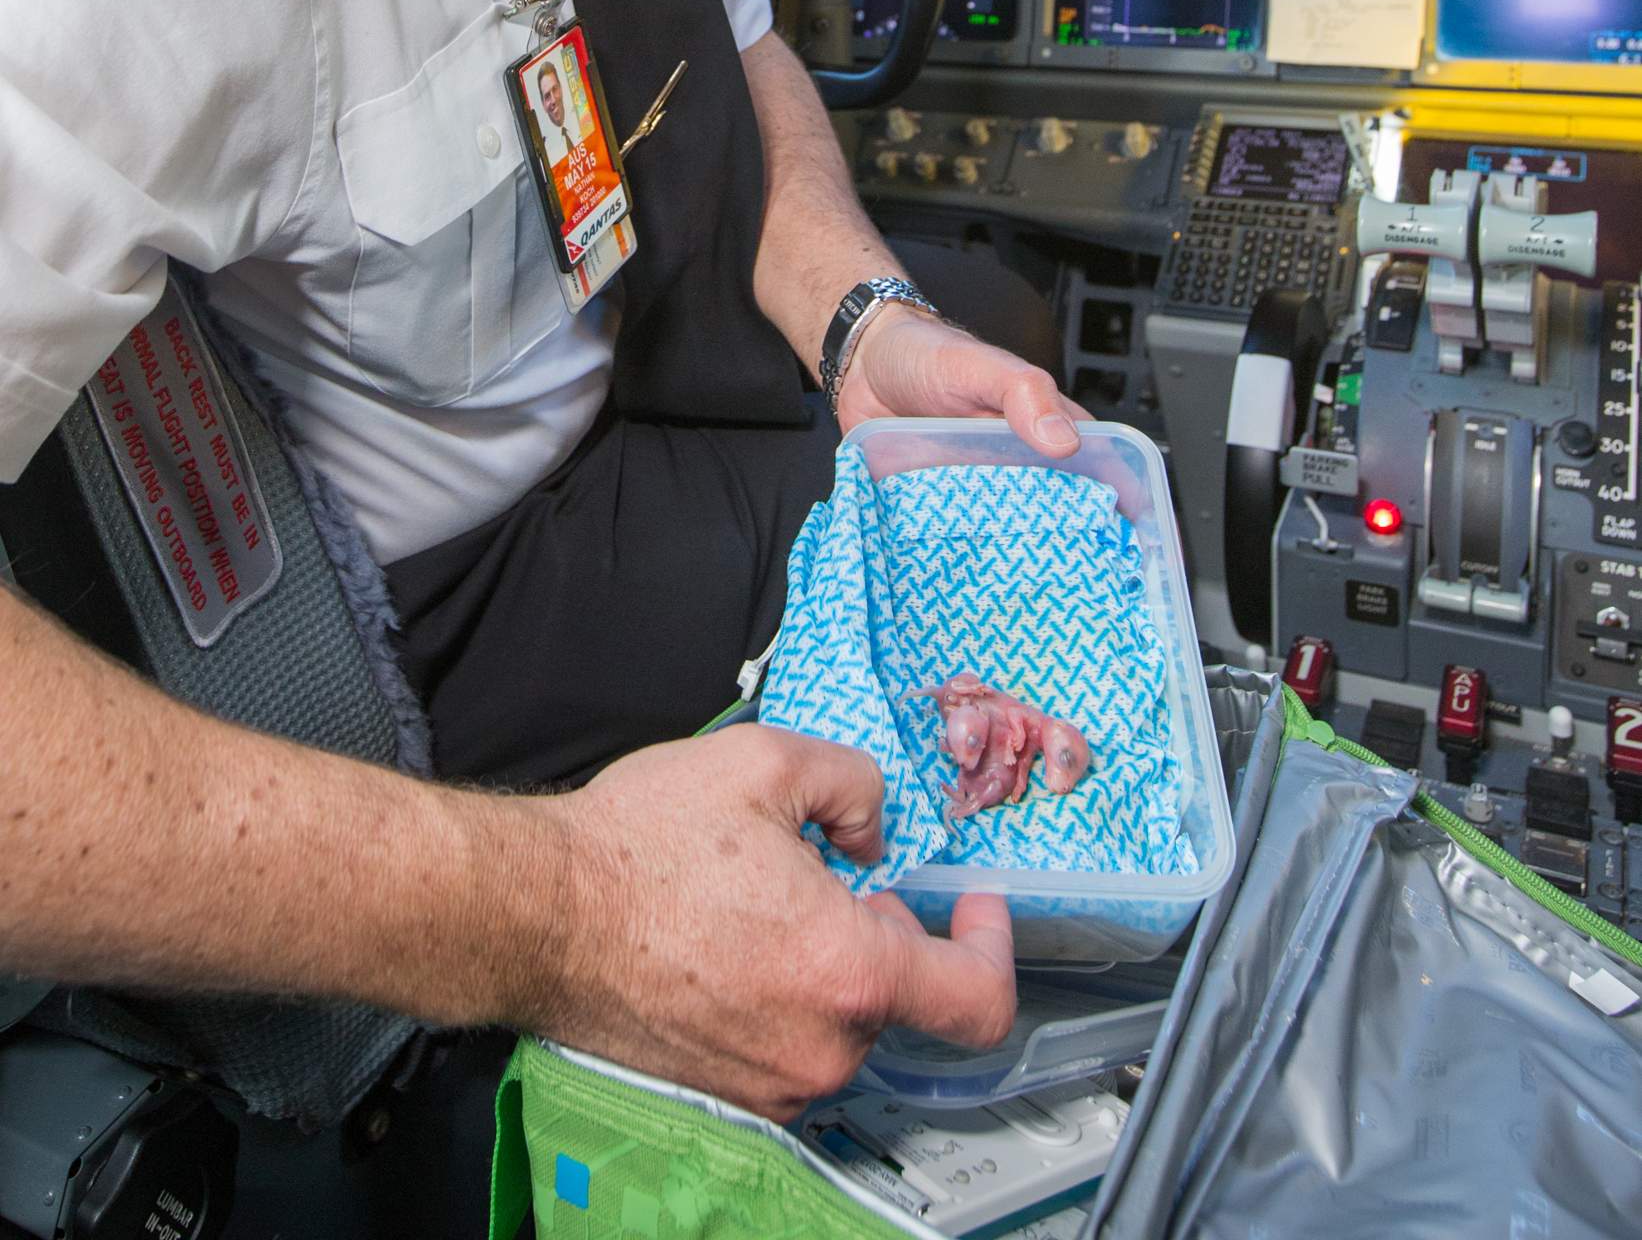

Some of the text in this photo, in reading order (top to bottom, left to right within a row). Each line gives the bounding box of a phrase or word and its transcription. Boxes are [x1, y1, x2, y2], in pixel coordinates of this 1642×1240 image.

[567, 143, 588, 170] AUS
[564, 161, 585, 191] MAY
[581, 197, 622, 247] QANTAS
[1406, 206, 1418, 222] 1
[1529, 215, 1545, 233] 2
[1384, 234, 1438, 246] DISENGAGE
[1507, 245, 1566, 259] DISENGAGE
[1610, 340, 1628, 353] 10
[1610, 368, 1627, 382] 15
[1603, 400, 1625, 417] 25
[164, 316, 261, 551] BACK REST MUST BE IN
[1600, 436, 1624, 455] 30
[130, 323, 241, 606] RMAL FLIGHT POSITION WHEN
[1302, 461, 1338, 475] BRAKE
[98, 356, 208, 612] EAT IS MOVING OUTBOARD
[1302, 471, 1334, 486] PULL
[1597, 484, 1623, 502] 40
[1603, 514, 1636, 529] FLAP
[1601, 524, 1637, 540] DOWN
[1600, 559, 1636, 578] STAB
[1295, 644, 1315, 680] 1
[1452, 673, 1473, 713] APU
[1614, 707, 1642, 748] 2
[156, 1189, 195, 1229] LUMBAR
[144, 1212, 182, 1240] IN-OUT
